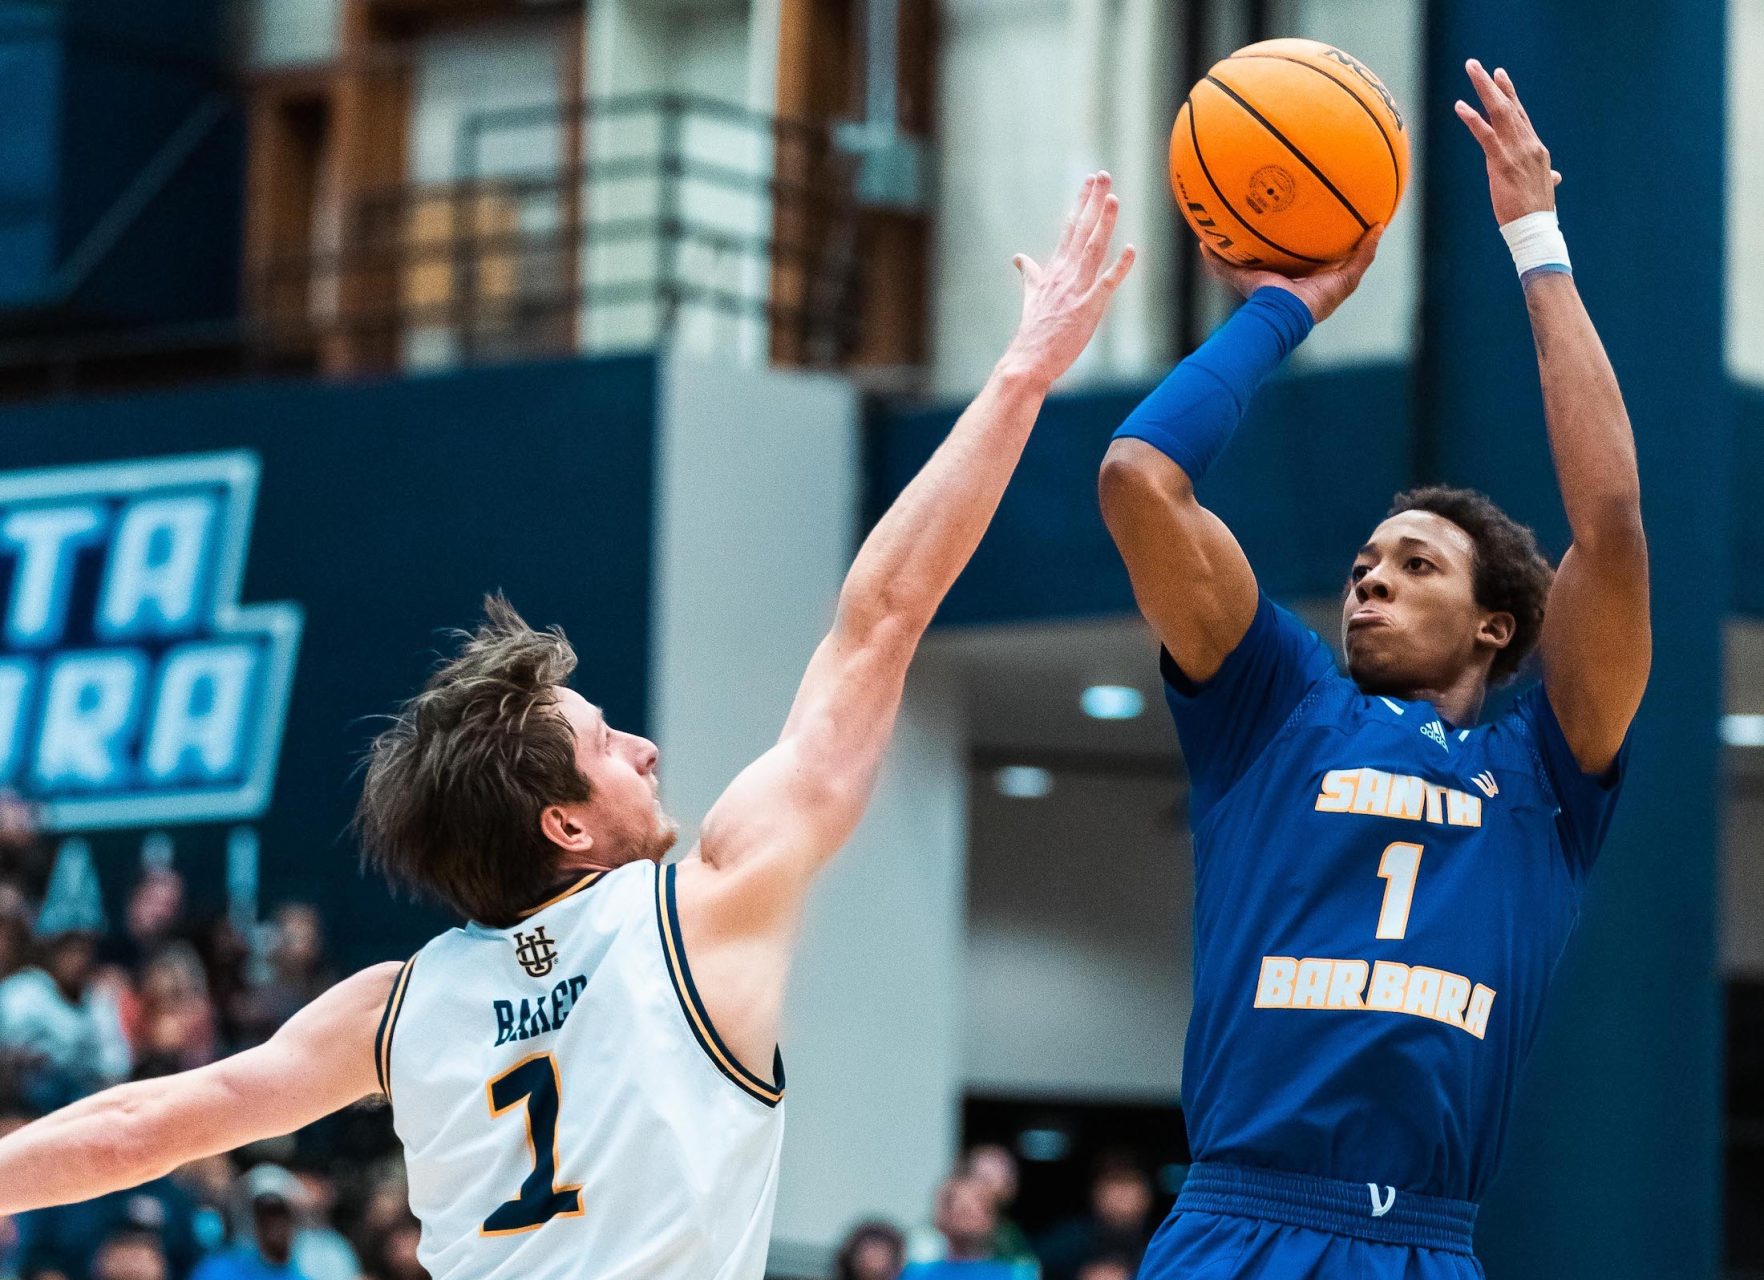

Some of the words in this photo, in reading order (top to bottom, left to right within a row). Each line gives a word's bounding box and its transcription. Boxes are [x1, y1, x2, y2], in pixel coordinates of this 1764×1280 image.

[1315, 768, 1482, 827] SANTA
[1376, 842, 1424, 939] 1
[1254, 956, 1496, 1040] BARBARA
[478, 1050, 586, 1237] 1
